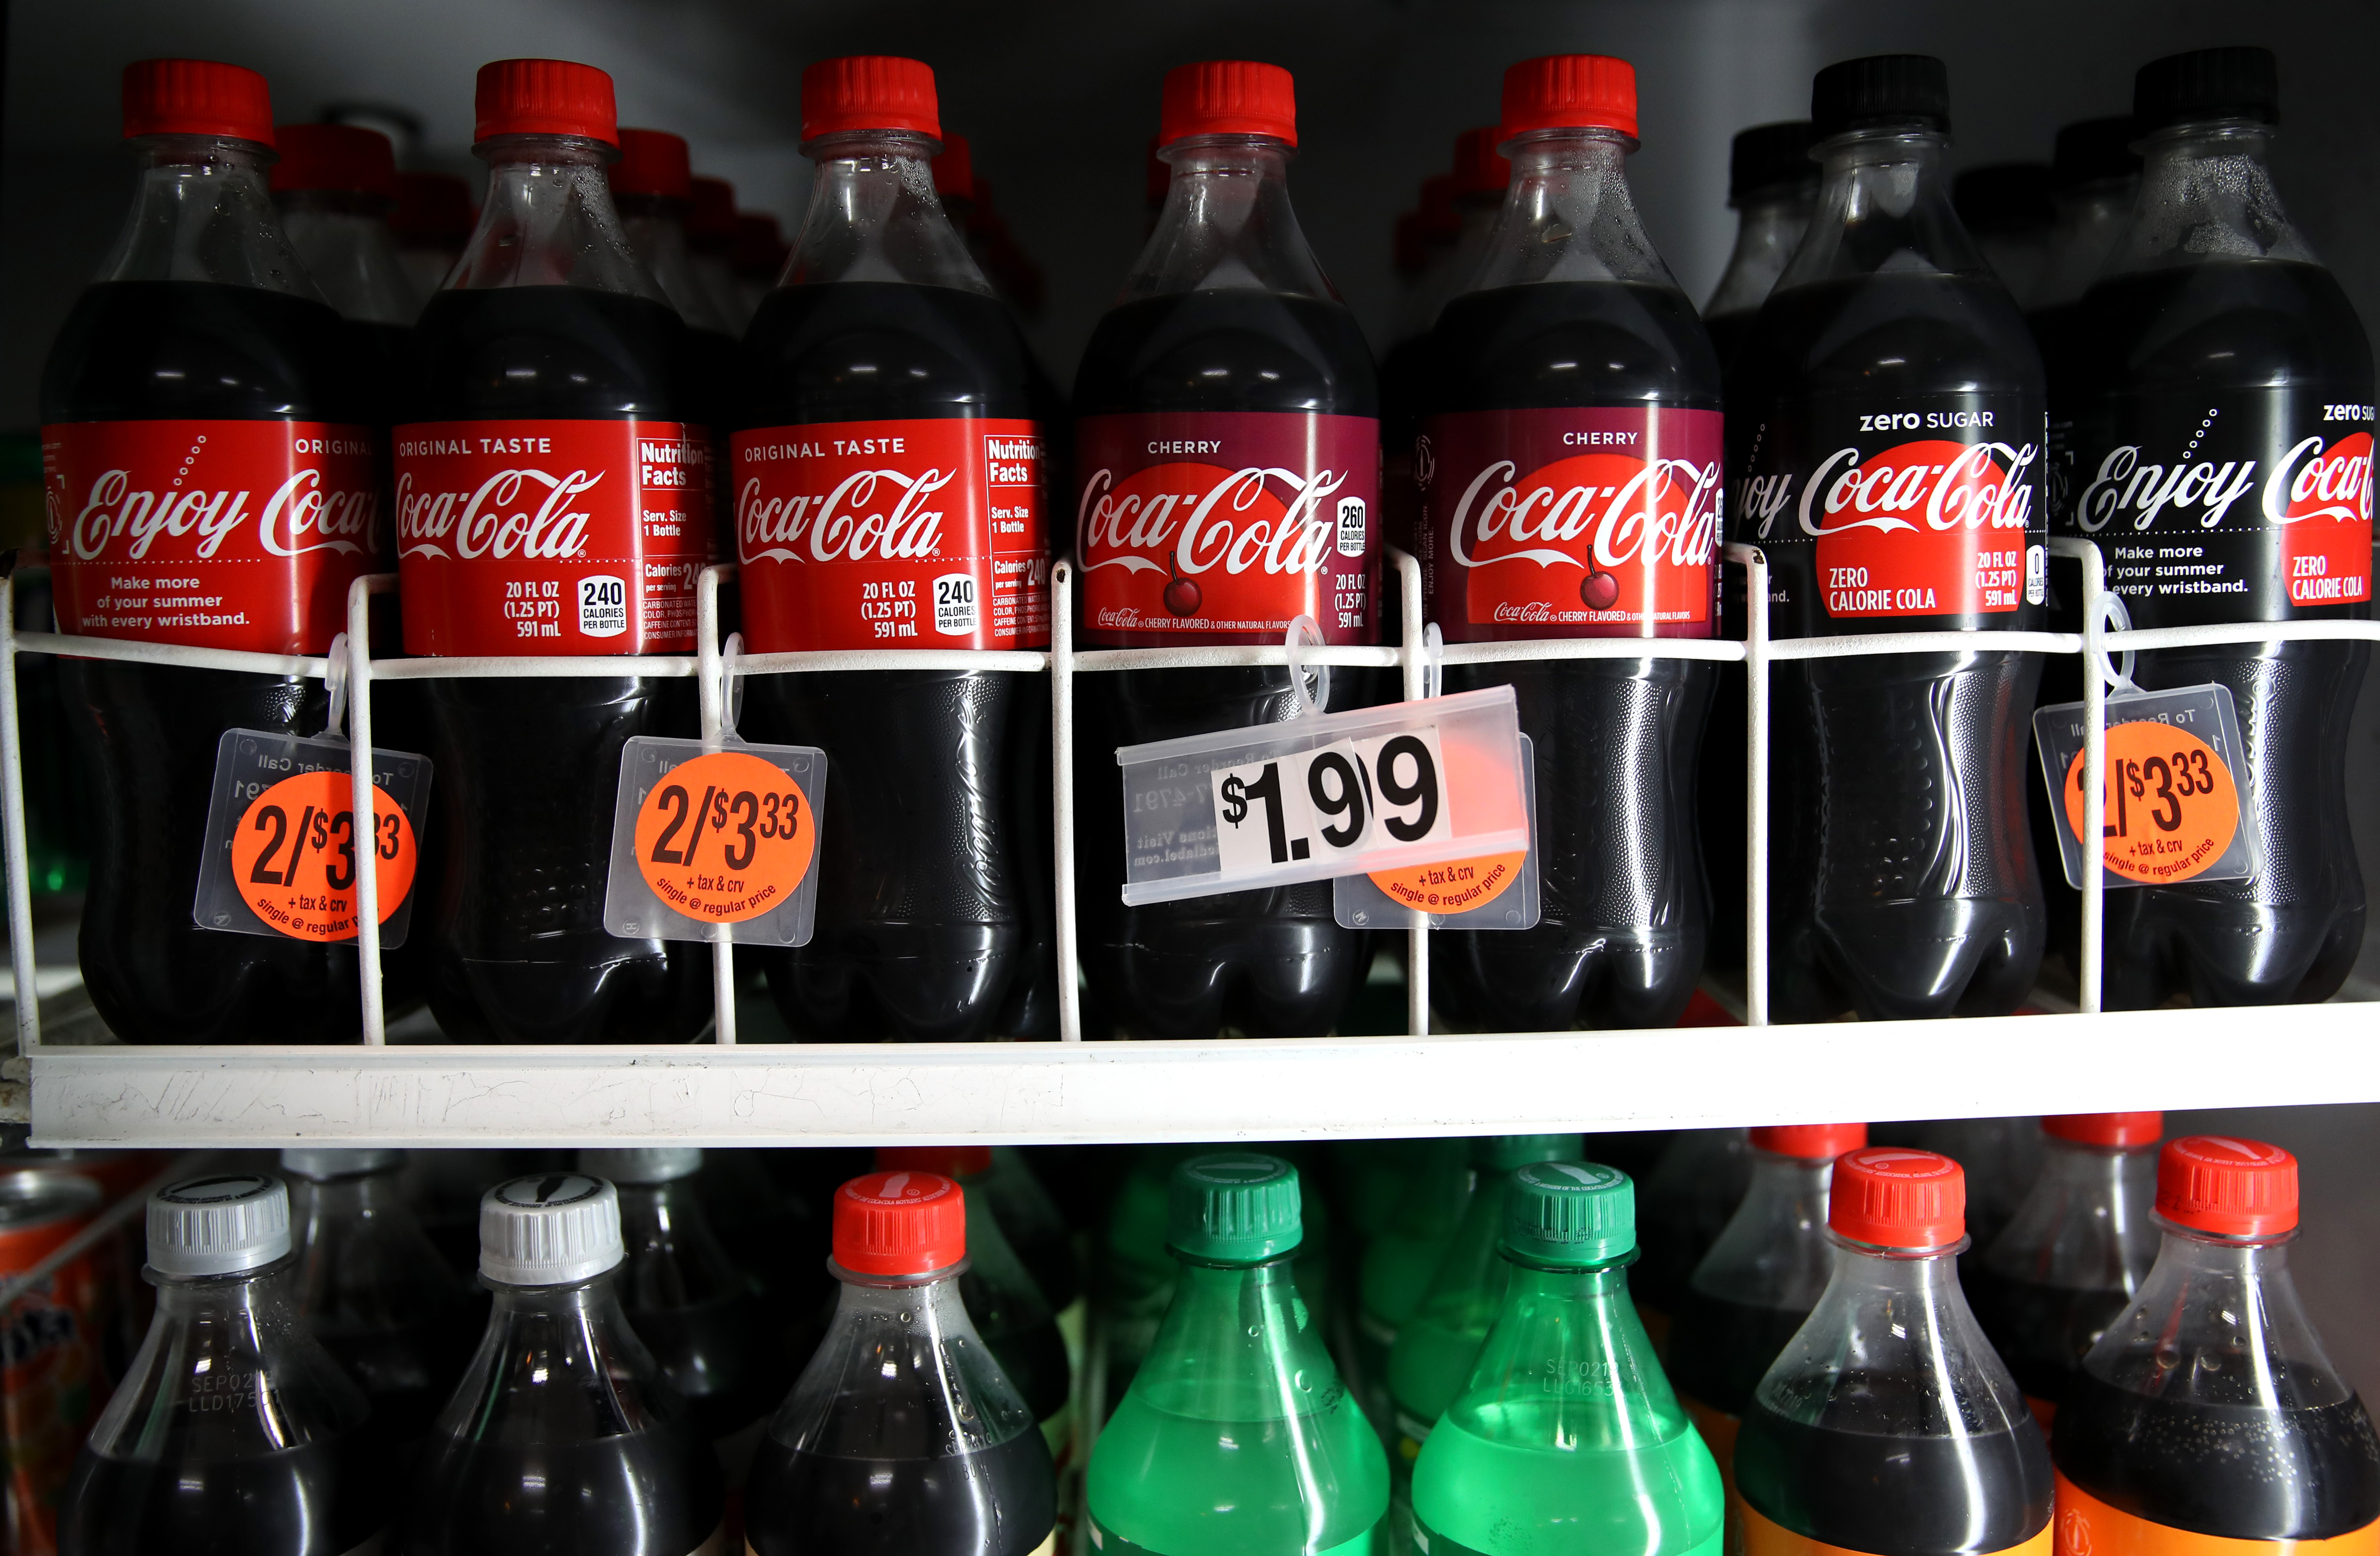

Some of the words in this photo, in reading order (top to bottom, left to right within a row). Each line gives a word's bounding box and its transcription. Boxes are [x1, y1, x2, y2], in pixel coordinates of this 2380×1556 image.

[1859, 412, 1920, 431] zero
[1927, 411, 1994, 428] SUGAR
[2323, 404, 2360, 421] zero
[1148, 440, 1221, 454] CHERRY
[1563, 431, 1638, 445] CHERRY
[295, 439, 373, 456] ORIGINAL
[400, 440, 472, 457] ORIGINAL
[480, 438, 551, 454] TASTE
[641, 442, 704, 465] Nutrition
[745, 443, 825, 462] ORIGINAL
[834, 438, 905, 456] TASTE
[988, 440, 1040, 460] Nutrition
[642, 465, 686, 486] Facts
[990, 462, 1028, 482] Facts
[1799, 442, 2038, 536] Coca-Cola
[2078, 445, 2257, 533] Enjoy
[73, 469, 250, 560] Enjoy
[396, 469, 606, 560] Coca-Cola
[643, 510, 668, 522] Serv.
[669, 510, 686, 522] Size
[738, 468, 957, 565] Coca-Cola
[991, 507, 1013, 519] Serv.
[1014, 506, 1029, 518] Size
[1076, 467, 1348, 576] Coca-Cola
[1342, 505, 1363, 529] 260
[1450, 459, 1721, 569] Coca-Cola
[644, 524, 649, 536] 1
[653, 524, 681, 536] Bottle
[992, 521, 998, 533] 1
[1000, 521, 1024, 533] Bottle
[1341, 530, 1364, 540] CALORIES
[1340, 542, 1349, 551] PER
[1351, 542, 1366, 551] BOTTLE
[2115, 546, 2154, 559] Make
[2159, 547, 2203, 558] more
[1978, 553, 1990, 568] 20
[1993, 552, 2003, 567] FL
[2005, 551, 2016, 567] OZ
[2034, 553, 2039, 574] 0
[2292, 556, 2326, 577] ZERO
[645, 564, 682, 577] Calories
[683, 562, 706, 590] 24
[995, 560, 1026, 574] Calories
[1027, 558, 1046, 586] 240
[1829, 567, 1868, 588] ZERO
[1975, 571, 1998, 589] (1.25
[2000, 570, 2017, 588] PT)
[2117, 567, 2151, 579] your
[2155, 564, 2224, 576] summer
[111, 577, 150, 590] Make
[156, 577, 200, 589] more
[506, 582, 522, 598] 20
[525, 582, 539, 598] FL
[542, 581, 559, 597] OZ
[646, 584, 656, 593] per
[657, 583, 677, 592] serving
[863, 583, 879, 599] 20
[881, 583, 896, 599] FL
[898, 581, 916, 598] OZ
[995, 581, 1004, 590] per
[1005, 579, 1022, 588] serving
[1336, 574, 1346, 590] 20
[1348, 574, 1356, 590] FL
[1357, 574, 1365, 589] OZ
[2112, 585, 2153, 596] every
[2159, 579, 2249, 594] wristband.
[2292, 577, 2341, 600] CALORIE
[2343, 575, 2362, 597] COLA
[584, 582, 622, 606] 240
[938, 579, 974, 605] 240
[1829, 589, 1891, 611] CALORIE
[1896, 588, 1935, 609] COLA
[1985, 590, 2001, 606] 591
[2004, 590, 2016, 605] mL
[97, 595, 110, 608] of
[114, 598, 148, 609] your
[153, 595, 222, 608] summer
[504, 602, 534, 619] (1.25
[538, 601, 560, 619] PT)
[643, 600, 683, 609] CARBONATED
[861, 603, 892, 621] (1.25
[894, 600, 917, 619] PT)
[993, 597, 1027, 606] CARBONATED
[1335, 593, 1354, 611] (1.25
[1356, 593, 1366, 610] PT)
[82, 614, 107, 627] with
[111, 617, 152, 629] every
[158, 611, 250, 626] wristband.
[583, 609, 624, 619] CALORIES
[643, 610, 667, 619] COLOR,
[938, 605, 976, 617] CALORIES
[993, 607, 1015, 616] COLOR,
[1098, 607, 1140, 628] Coca-Cola
[1145, 617, 1171, 629] CHERRY
[1173, 618, 1209, 630] FLAVORED
[1216, 621, 1236, 630] OTHER
[1237, 621, 1265, 630] NATURAL
[1338, 612, 1351, 628] 591
[1353, 612, 1364, 627] mL
[1494, 601, 1553, 622] Coca-Cola
[1558, 610, 1588, 622] CHERRY
[1589, 610, 1626, 622] FLAVORED
[1626, 613, 1631, 621] &
[1632, 612, 1646, 621] OTH
[1651, 611, 1672, 620] ATURAL
[1672, 611, 1690, 620] FLAVORS
[517, 622, 538, 638] 591
[541, 622, 561, 637] mL
[583, 620, 597, 629] PER
[599, 619, 625, 629] BOTTLE
[644, 620, 669, 630] CAFFEINE
[874, 622, 895, 638] 591
[898, 620, 918, 637] mL
[939, 619, 952, 628] PER
[953, 616, 977, 628] BOTTLE
[994, 617, 1016, 626] CAFFEINE
[644, 630, 677, 640] CONSUMER
[995, 627, 1022, 637] CONSUMER
[2138, 841, 2155, 856] tax
[2156, 839, 2165, 854] &
[2167, 839, 2183, 853] crv
[2103, 851, 2134, 871] single
[2139, 863, 2149, 874] @
[2153, 857, 2191, 876] regular
[2191, 838, 2214, 863] price
[698, 874, 714, 890] tax
[716, 875, 724, 891] &
[728, 880, 745, 892] crv
[1390, 882, 1424, 903] single
[1428, 894, 1439, 905] @
[1443, 885, 1482, 906] regular
[1482, 864, 1505, 890] price
[1428, 870, 1445, 885] tax
[1447, 867, 1457, 882] &
[1458, 867, 1474, 880] crv
[300, 895, 316, 910] tax
[319, 896, 327, 910] &
[330, 899, 347, 912] crv
[657, 878, 687, 904] single
[690, 898, 701, 909] @
[703, 900, 745, 917] regular
[748, 885, 776, 909] price
[257, 899, 289, 924] single
[292, 918, 304, 929] @
[306, 919, 349, 935] regular
